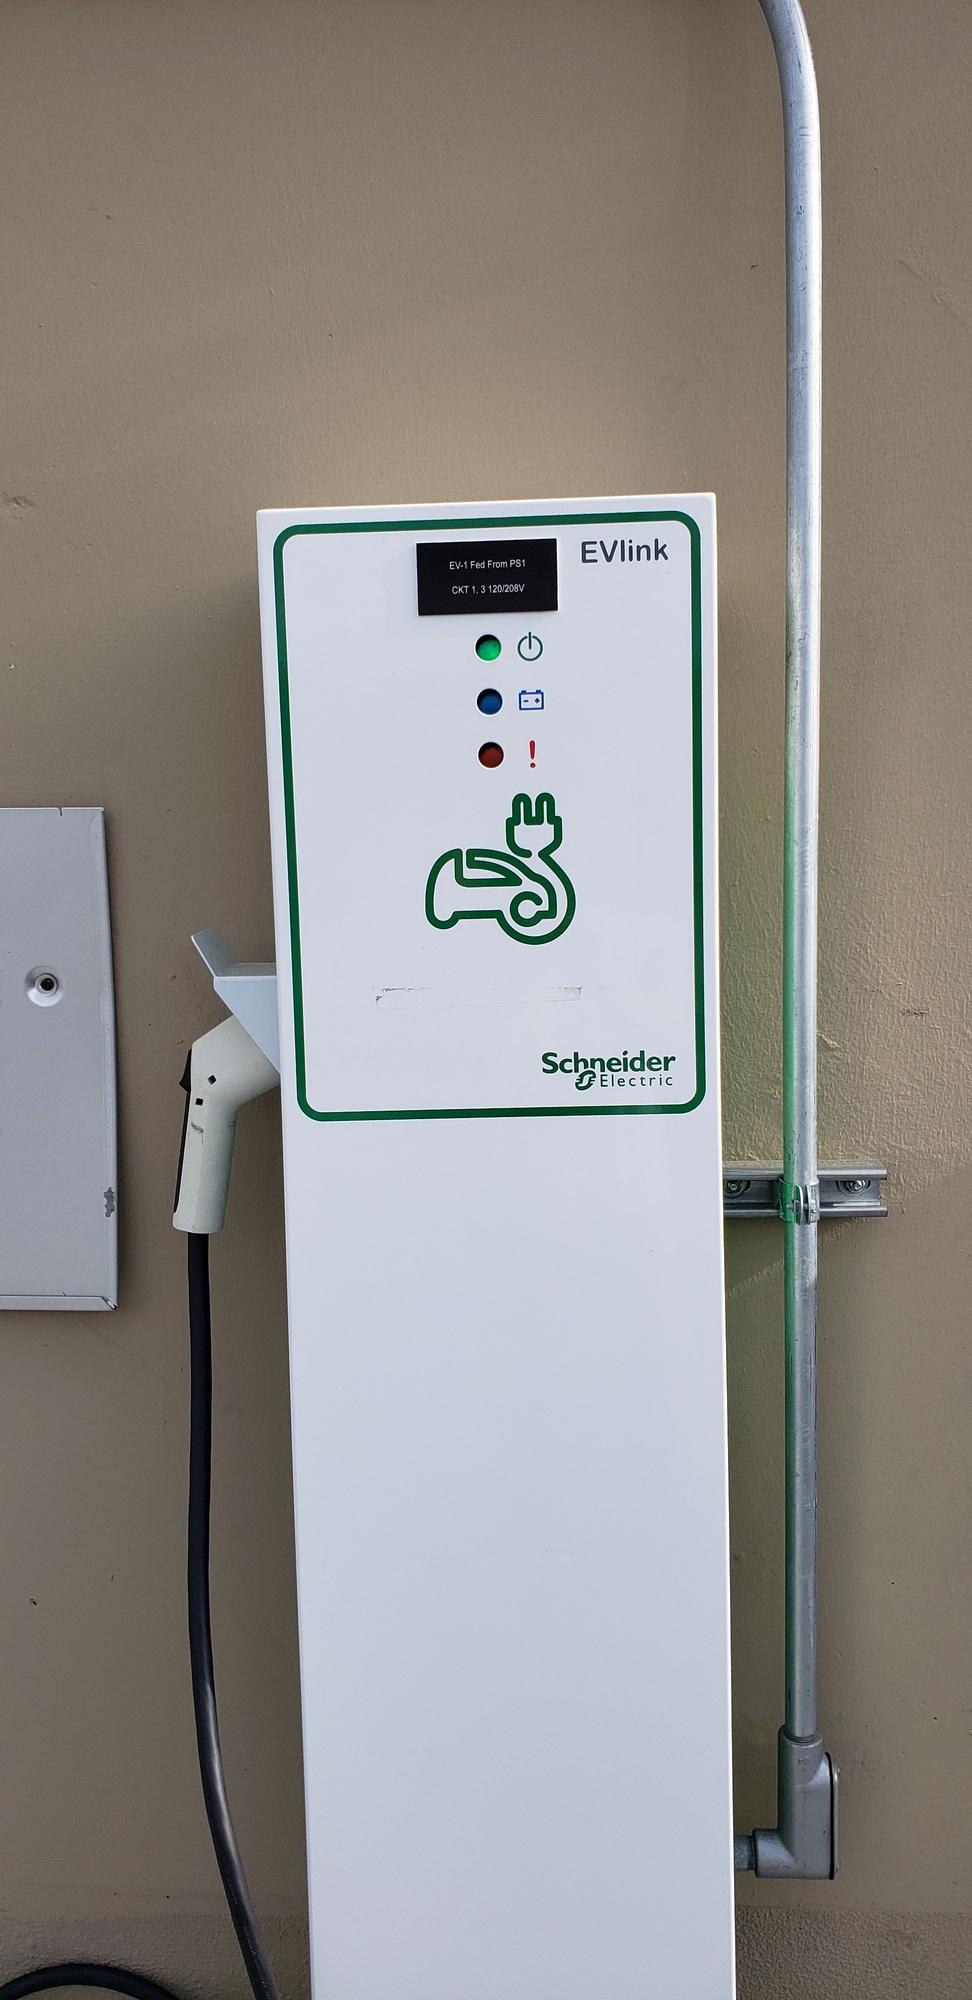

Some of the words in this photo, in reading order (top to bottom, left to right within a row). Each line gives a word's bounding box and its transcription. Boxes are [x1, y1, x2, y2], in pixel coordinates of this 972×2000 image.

[580, 538, 669, 564] EVlink
[449, 561, 468, 570] EV-1
[470, 560, 486, 569] Fed
[487, 559, 508, 569] From
[509, 558, 526, 568] PS1
[451, 585, 469, 595] CKT
[480, 585, 486, 594] 3
[488, 583, 525, 594] 120/208V
[541, 1050, 677, 1074] Schneider
[599, 1074, 674, 1088] Electric
